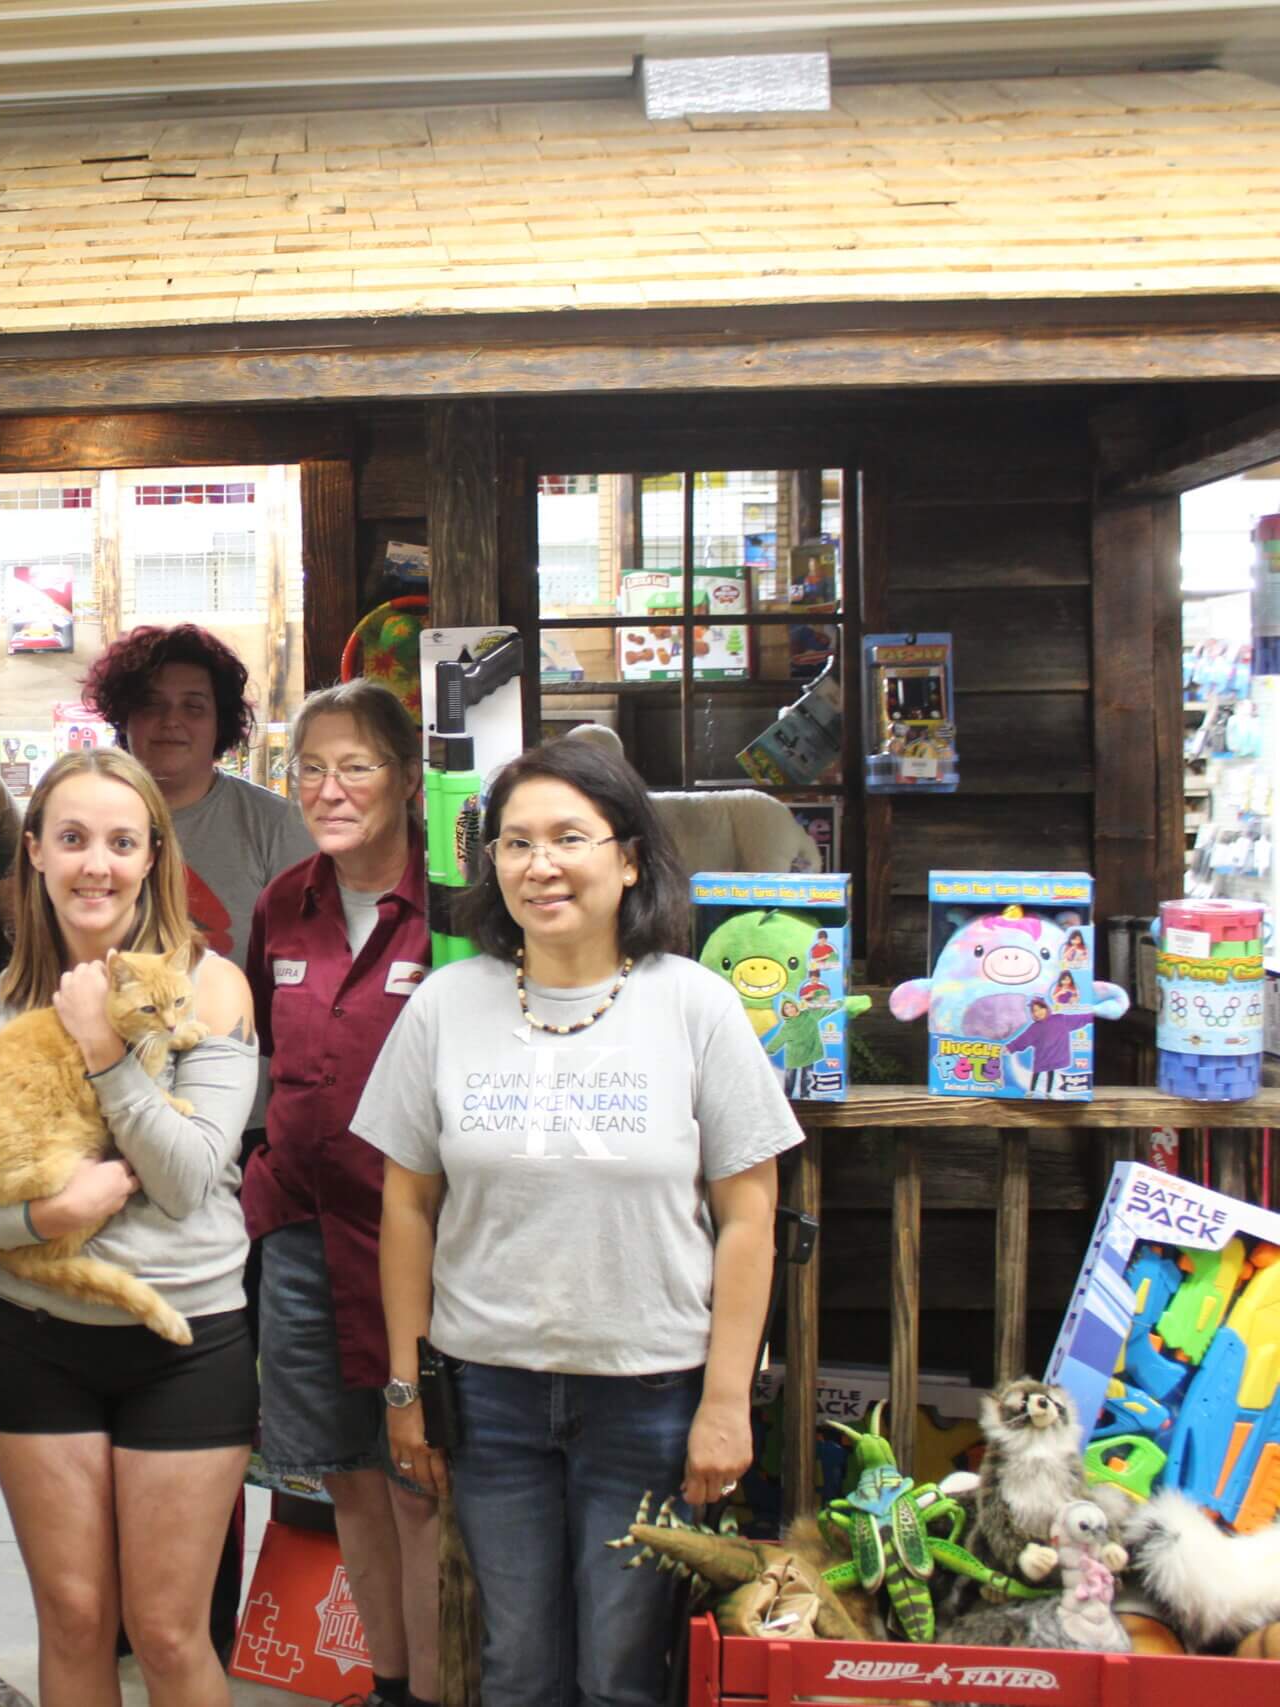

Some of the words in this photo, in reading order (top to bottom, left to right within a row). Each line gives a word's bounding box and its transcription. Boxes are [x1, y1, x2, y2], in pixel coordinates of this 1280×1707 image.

[939, 1040, 1002, 1058] HUGGLE
[465, 1072, 530, 1089] CALVIN
[535, 1072, 585, 1090] KLEIN
[587, 1071, 648, 1089] JEANS
[462, 1094, 529, 1111] CALVIN
[533, 1094, 584, 1112] KLEIN
[586, 1093, 648, 1111] JEANS
[460, 1115, 524, 1132] CALVIN
[530, 1115, 582, 1132] KLEIN
[583, 1115, 647, 1133] JEANS
[1132, 1181, 1228, 1225] BATTLE
[1126, 1197, 1222, 1244] PACK
[816, 1388, 861, 1400] TTLE
[816, 1401, 859, 1416] ACK
[825, 1659, 921, 1681] RADIO
[957, 1667, 1057, 1690] FLYER
